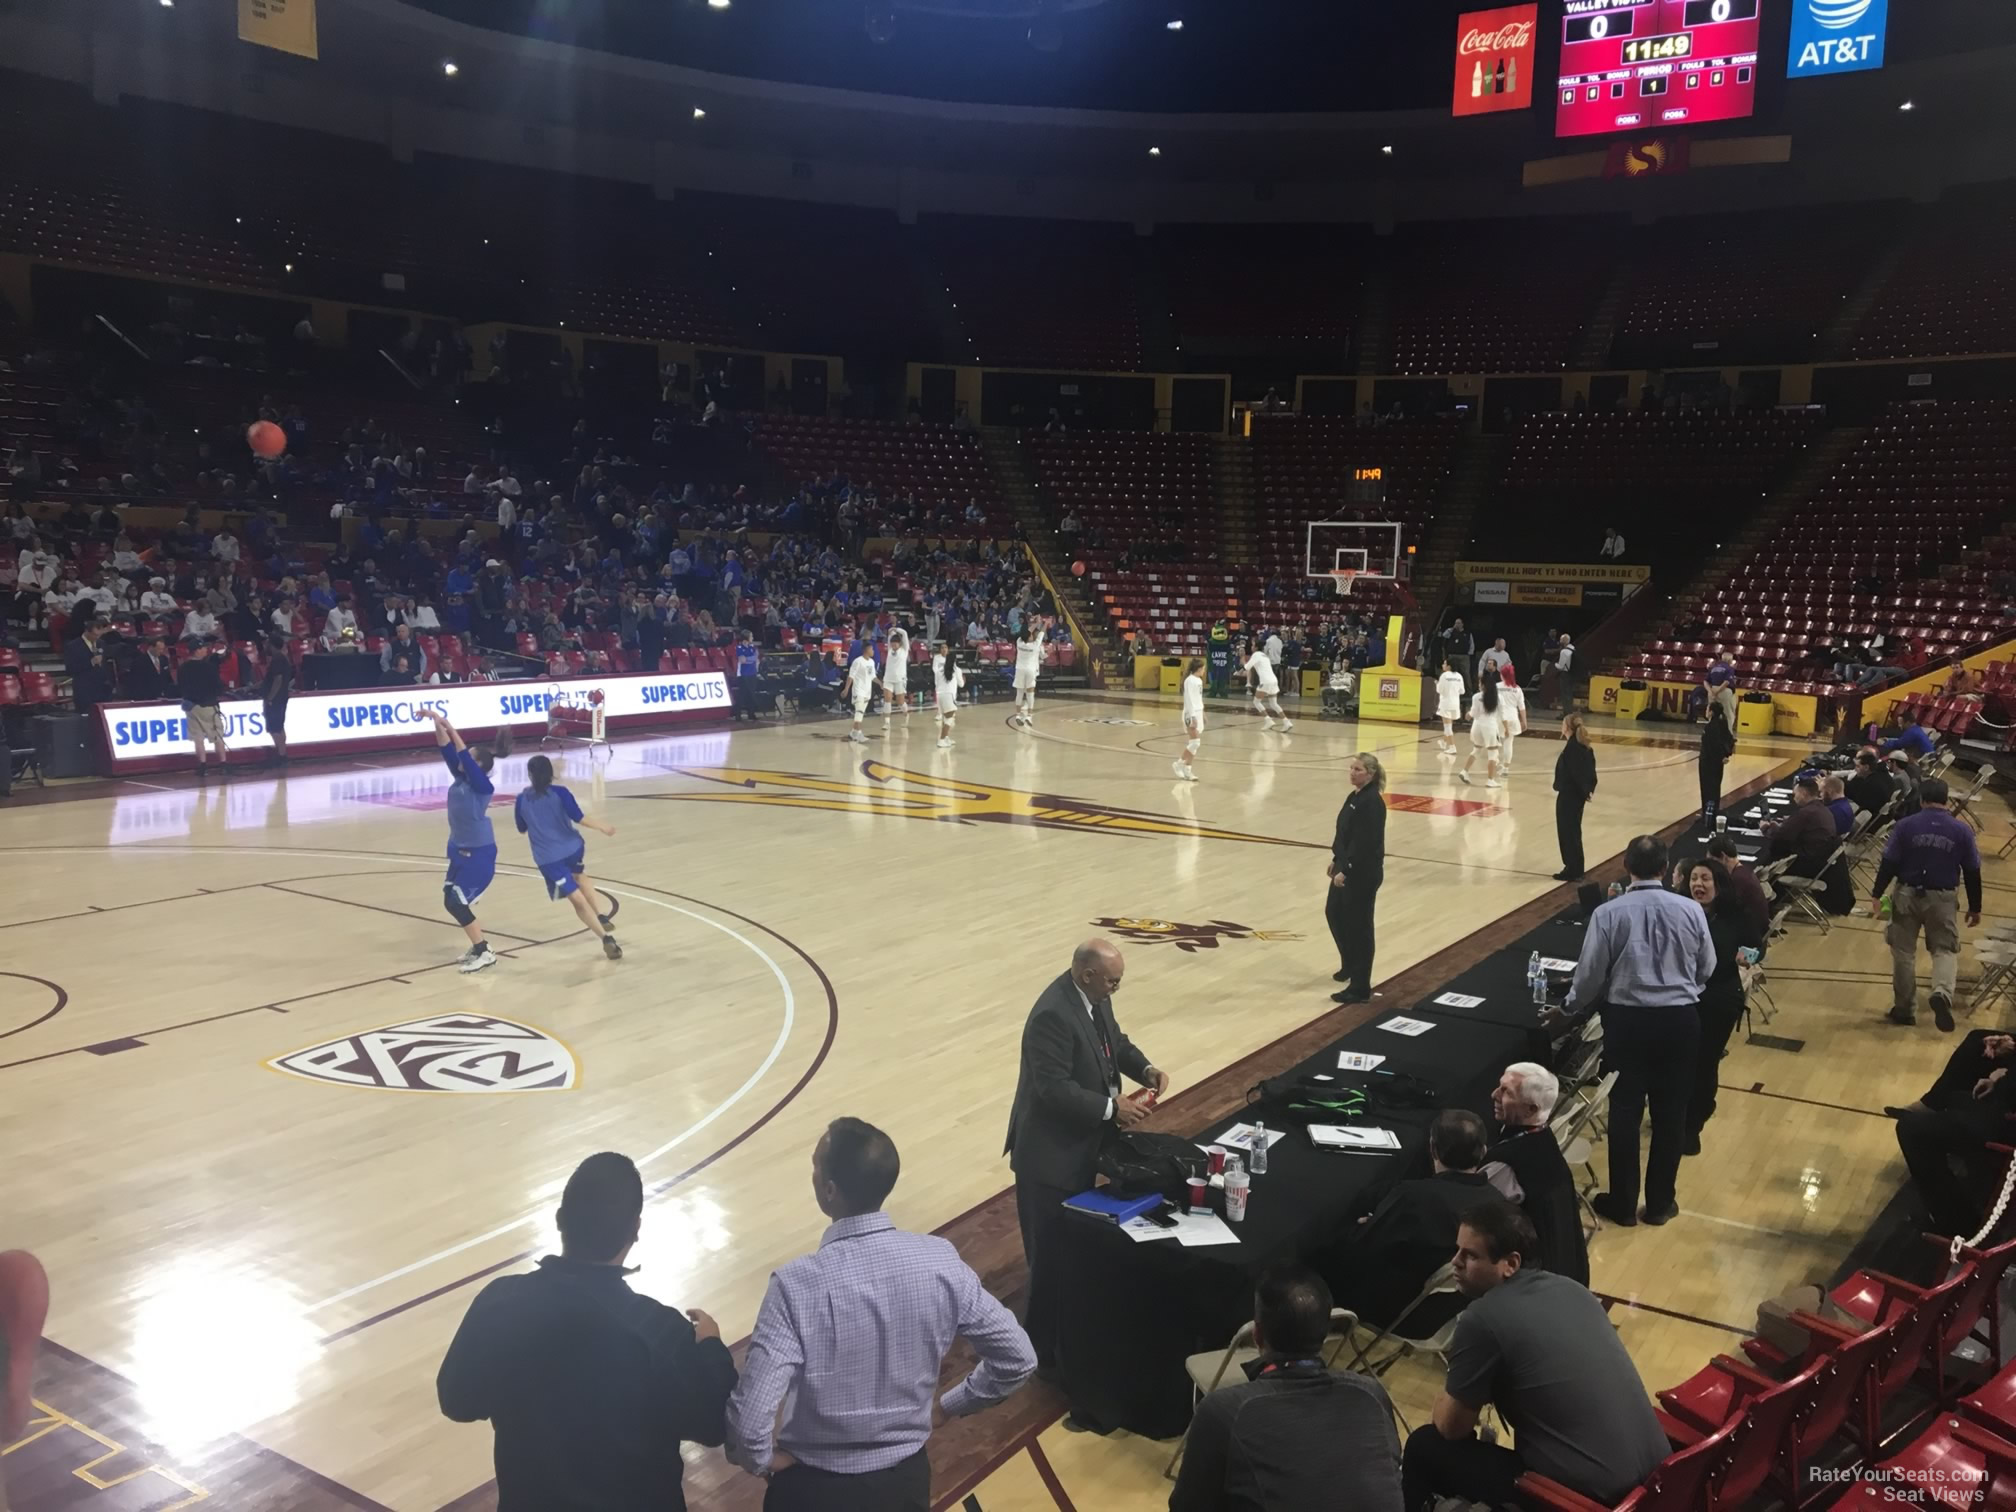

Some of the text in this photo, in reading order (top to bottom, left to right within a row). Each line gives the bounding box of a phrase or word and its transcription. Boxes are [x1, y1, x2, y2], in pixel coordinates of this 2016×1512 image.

[1711, 0, 1730, 22] 0
[1460, 21, 1535, 55] Coca-Cola
[1590, 15, 1608, 39] 0
[1625, 35, 1689, 61] 11:49
[1797, 34, 1876, 68] AT&T
[1637, 64, 1673, 77] PERIOD
[1649, 80, 1658, 92] 1
[1355, 468, 1382, 481] 11:49
[1470, 565, 1633, 578] ABANDON ALL HOPE YE WHO ENTER HERE
[641, 681, 724, 704] SUPERCUTS
[1381, 683, 1398, 692] ASU
[500, 690, 598, 715] SUPERCUT
